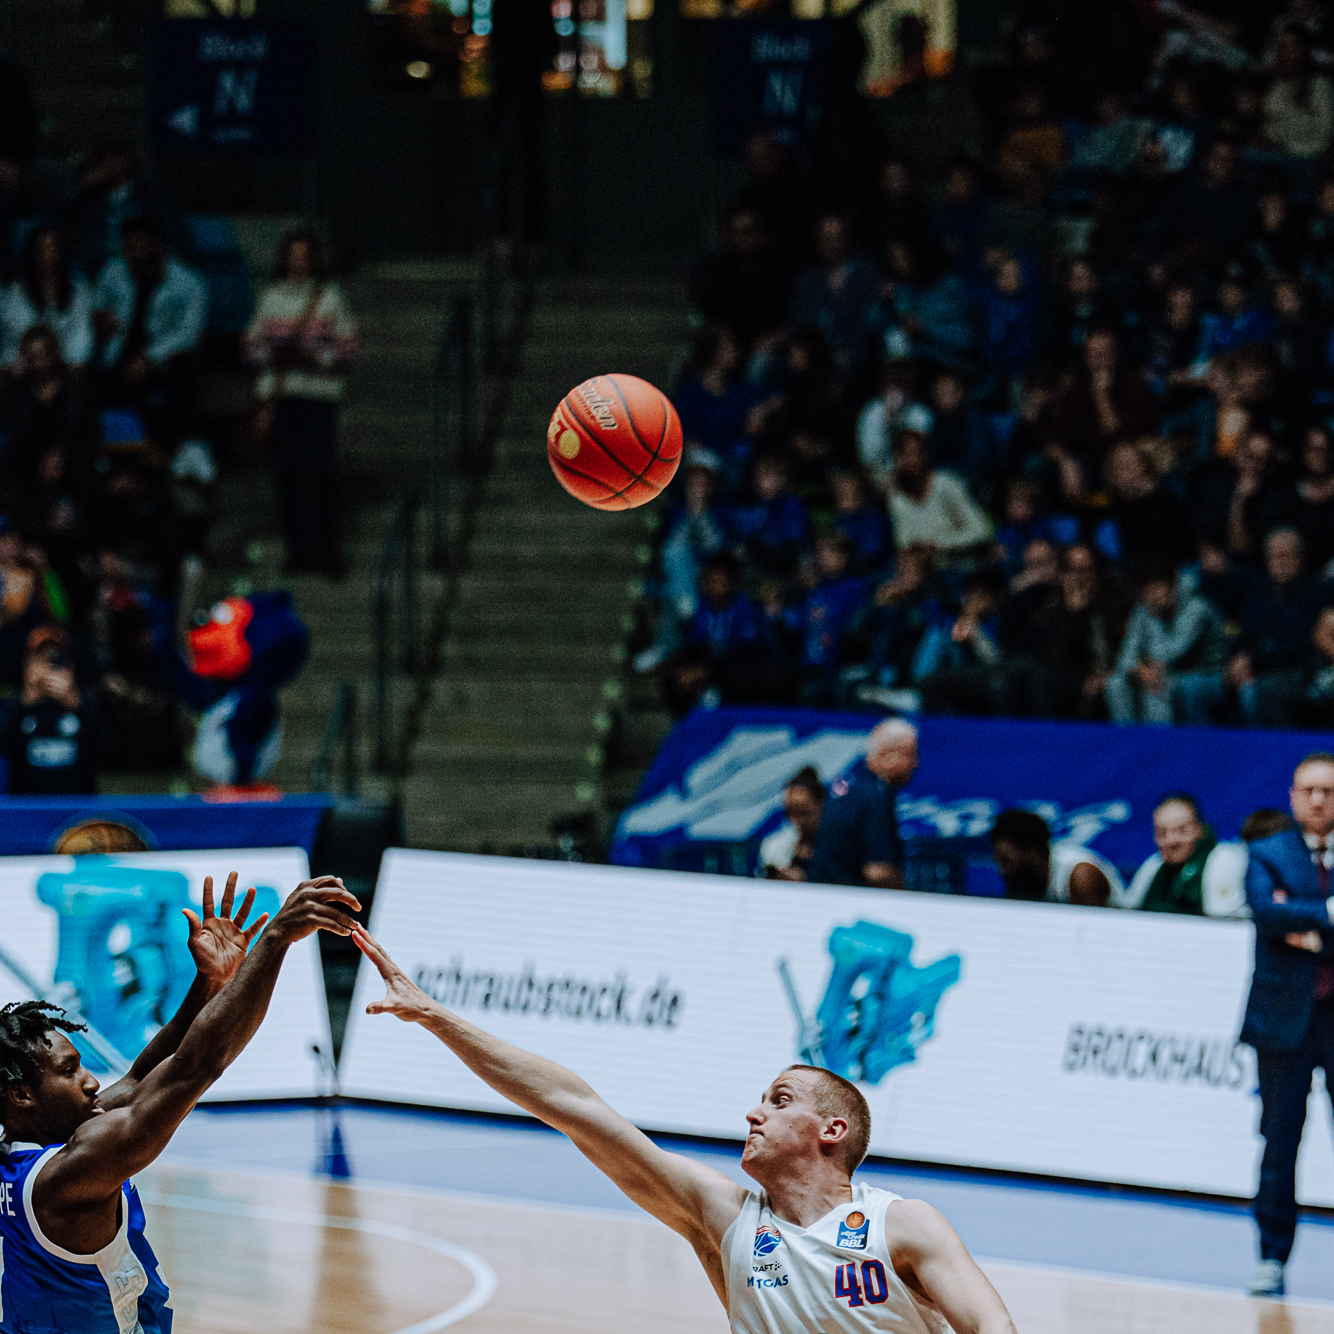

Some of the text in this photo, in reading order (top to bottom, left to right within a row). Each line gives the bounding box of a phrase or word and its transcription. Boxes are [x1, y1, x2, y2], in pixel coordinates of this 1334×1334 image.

[1064, 1026, 1244, 1091] BROCKHAUS
[839, 1238, 865, 1248] BBL
[752, 1263, 774, 1272] RAFT
[747, 1275, 789, 1289] MTGAS
[835, 1259, 889, 1308] 40
